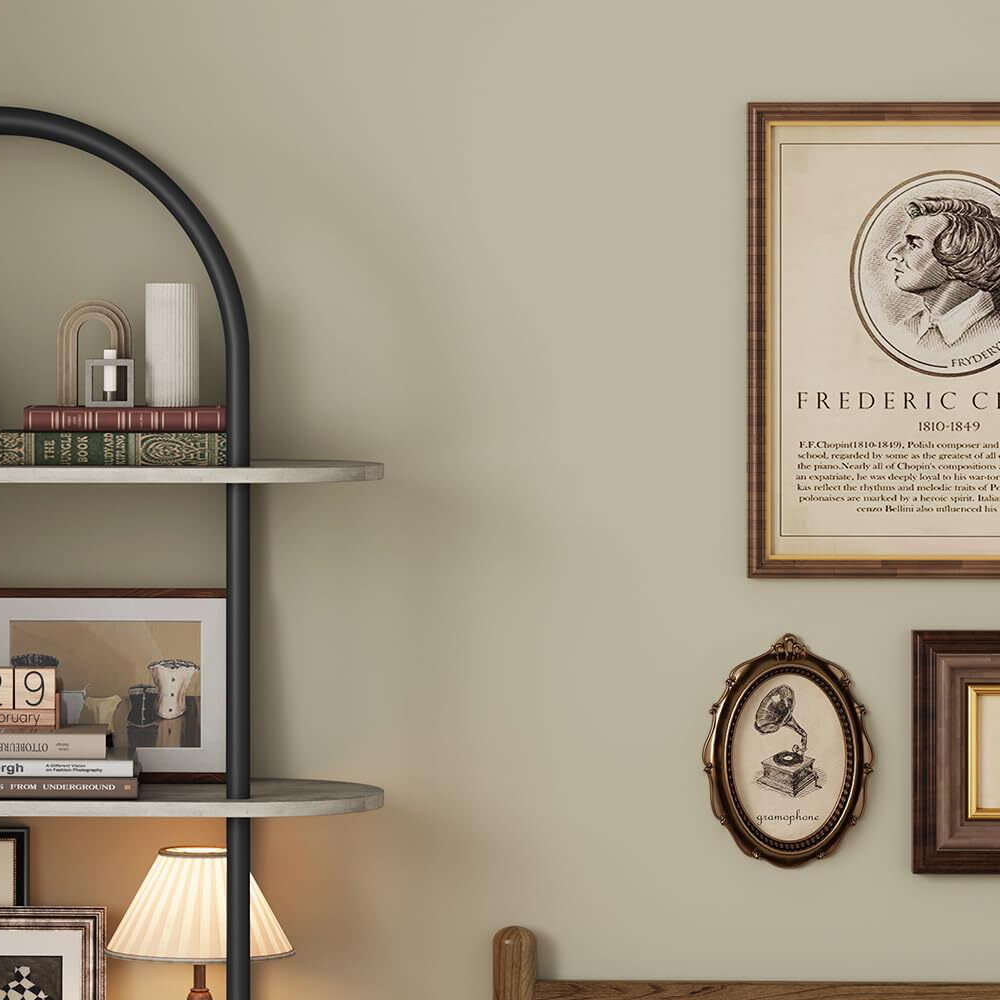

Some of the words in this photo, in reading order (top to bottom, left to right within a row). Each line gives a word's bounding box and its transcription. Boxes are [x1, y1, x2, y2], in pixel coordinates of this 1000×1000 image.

[951, 340, 1000, 367] FRYDERY
[797, 391, 957, 410] FREDERIC
[972, 391, 1000, 410] C
[918, 421, 981, 432] 1810-1849
[44, 439, 55, 460] THE
[77, 435, 89, 464] BOOK
[104, 432, 114, 465] UDYARD
[908, 441, 935, 449] Polish
[936, 442, 980, 450] composer
[983, 441, 1000, 449] and
[831, 452, 870, 460] regarded
[872, 452, 883, 460] by
[922, 452, 937, 460] the
[938, 452, 972, 460] greatest
[797, 462, 811, 470] the
[872, 462, 883, 470] all
[885, 462, 894, 470] of
[897, 462, 936, 471] Chopin's
[938, 463, 997, 471] compositions
[888, 473, 917, 482] deeply
[919, 473, 940, 482] loyal
[797, 483, 811, 491] kas
[814, 483, 841, 491] reflect
[843, 483, 857, 491] the
[859, 483, 896, 492] rhythms
[898, 483, 914, 491] and
[916, 483, 952, 491] melodic
[799, 494, 845, 503] polonaises
[863, 494, 897, 502] marked
[900, 494, 909, 503] by
[920, 494, 948, 502] heroic
[885, 505, 914, 513] Bellini
[916, 505, 934, 513] also
[936, 505, 982, 513] influenced
[984, 505, 998, 513] his
[10, 783, 37, 791] FROM
[42, 783, 116, 791] UNDERGROUND
[756, 809, 820, 825] gramophone
